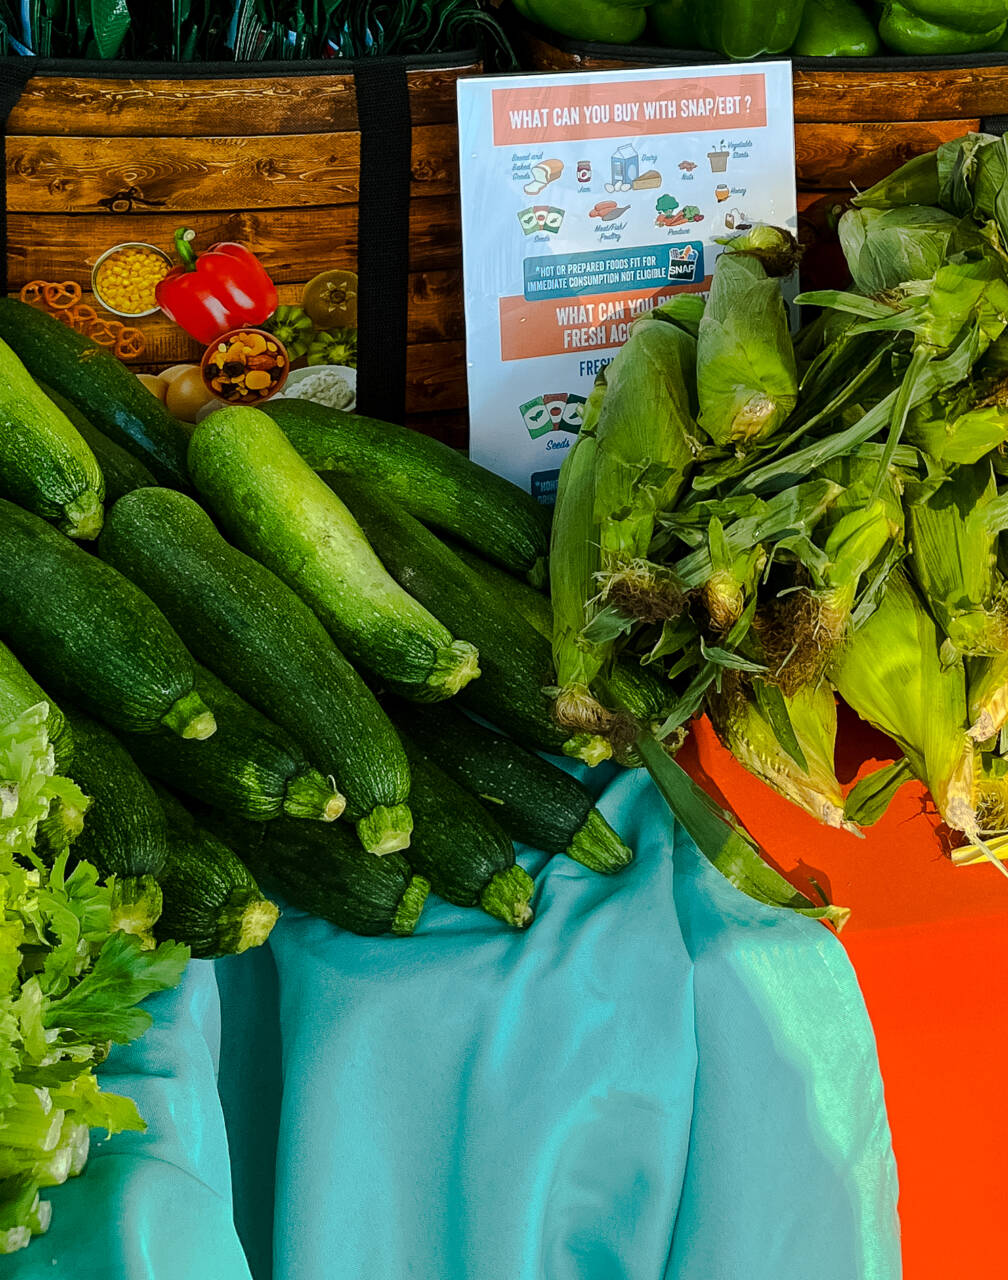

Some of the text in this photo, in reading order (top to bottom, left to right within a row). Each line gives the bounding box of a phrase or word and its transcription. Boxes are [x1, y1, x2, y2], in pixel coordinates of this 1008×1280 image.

[509, 108, 550, 129] WHAT
[553, 106, 580, 127] CAN
[584, 104, 610, 124] YOU
[614, 102, 640, 122] BUY
[643, 100, 677, 120] WITH
[680, 95, 741, 118] SNAP/EBT
[556, 265, 566, 275] OR
[567, 261, 604, 274] PREPARED
[606, 259, 628, 271] FOODS
[630, 257, 641, 268] FIT
[642, 255, 656, 267] FOR
[669, 263, 695, 275] SNAP
[527, 267, 666, 292] IMMEDIATE CONSUMPTION NOT ELIGIBLE
[556, 305, 595, 326] WHAT
[598, 302, 625, 321] CAN
[563, 326, 606, 349] FRESH
[545, 438, 570, 450] Seeds
